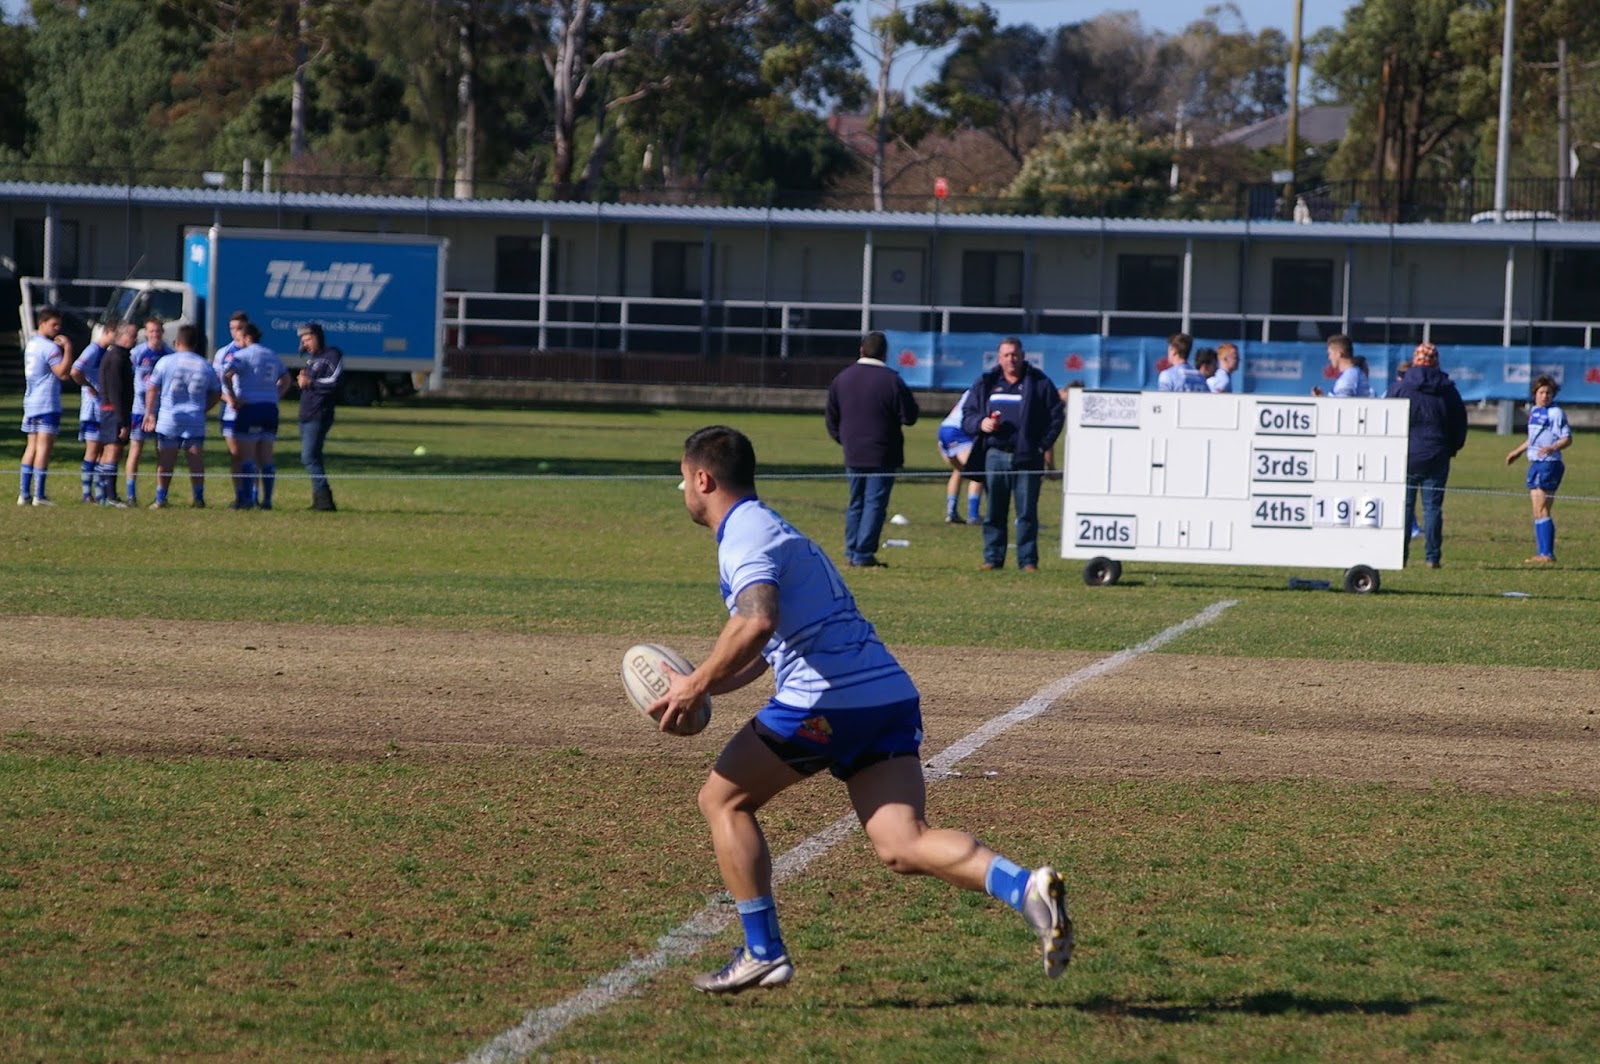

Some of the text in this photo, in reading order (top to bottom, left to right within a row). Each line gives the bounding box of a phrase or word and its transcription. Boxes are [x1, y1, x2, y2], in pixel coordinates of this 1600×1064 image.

[264, 260, 393, 312] Thrifty
[270, 318, 290, 330] Car
[1259, 408, 1310, 430] Colts
[1257, 454, 1308, 476] 3rds
[1255, 500, 1306, 522] 4ths
[1079, 519, 1130, 542] 2nds
